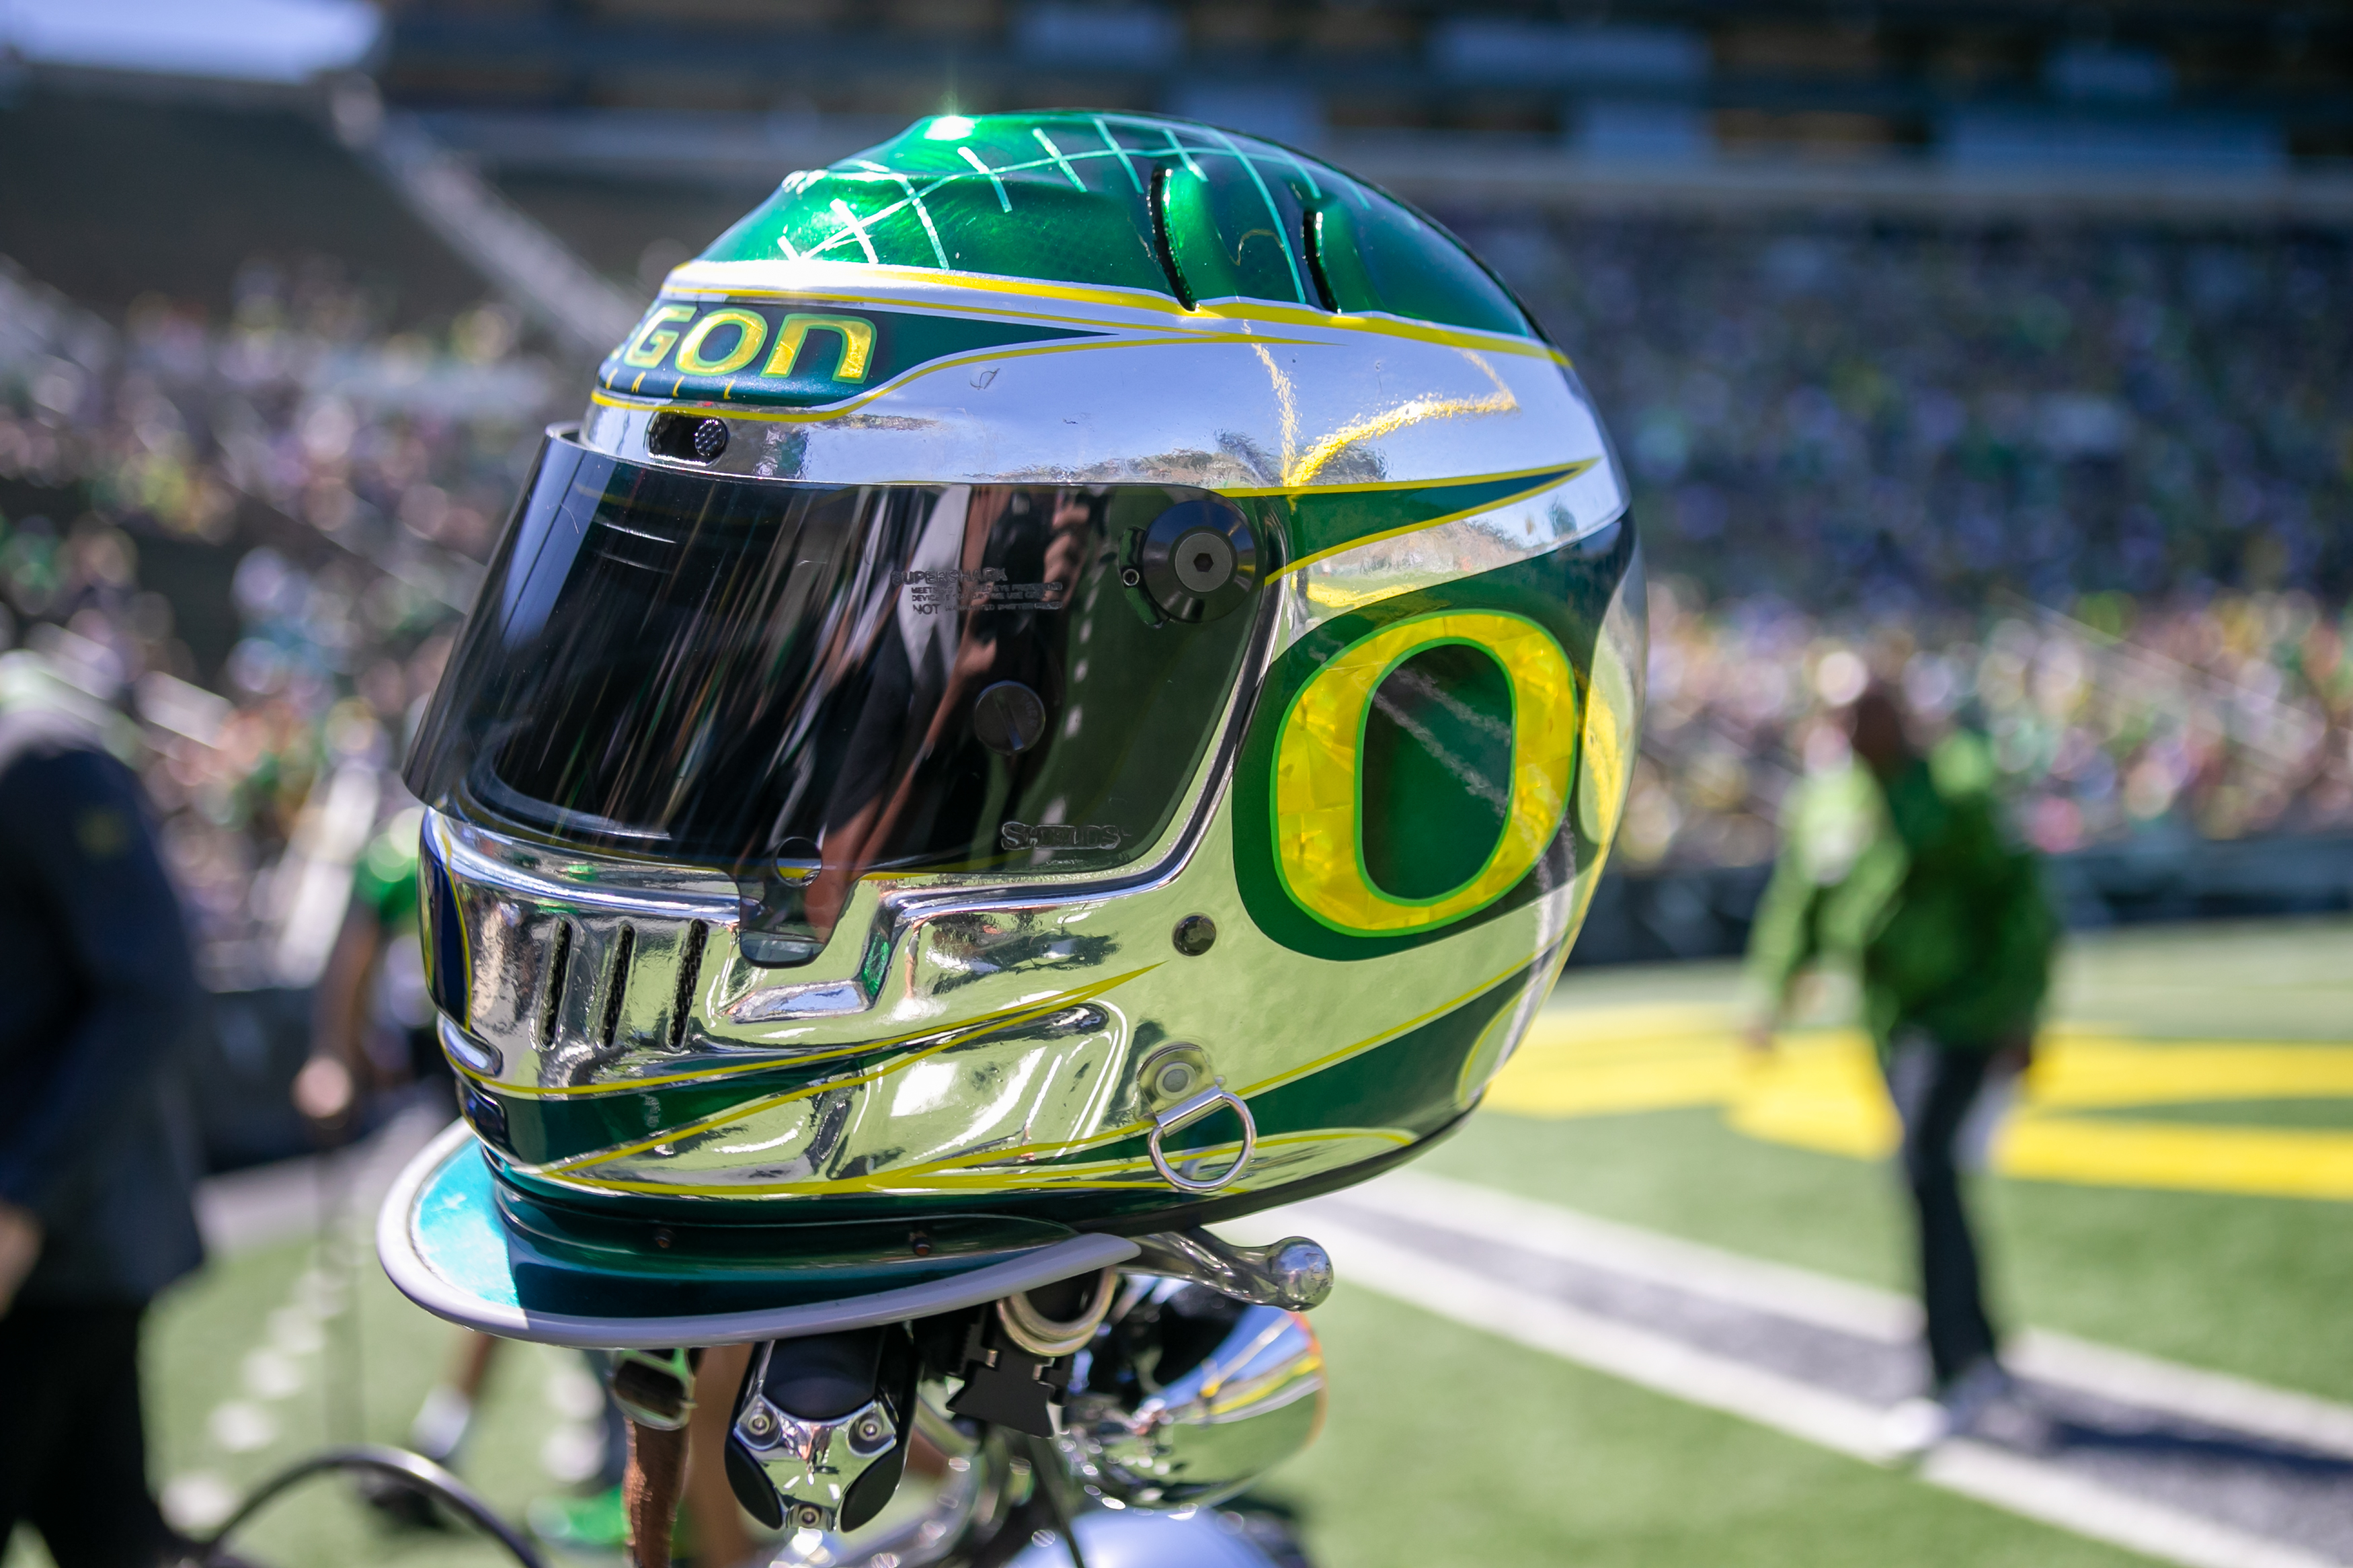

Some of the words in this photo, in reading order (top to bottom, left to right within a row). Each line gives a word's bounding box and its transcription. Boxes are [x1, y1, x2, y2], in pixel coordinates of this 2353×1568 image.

[608, 304, 877, 384] GON
[891, 567, 1008, 585] SUPERSHARK
[912, 604, 941, 615] NOT
[1269, 608, 1578, 938] O
